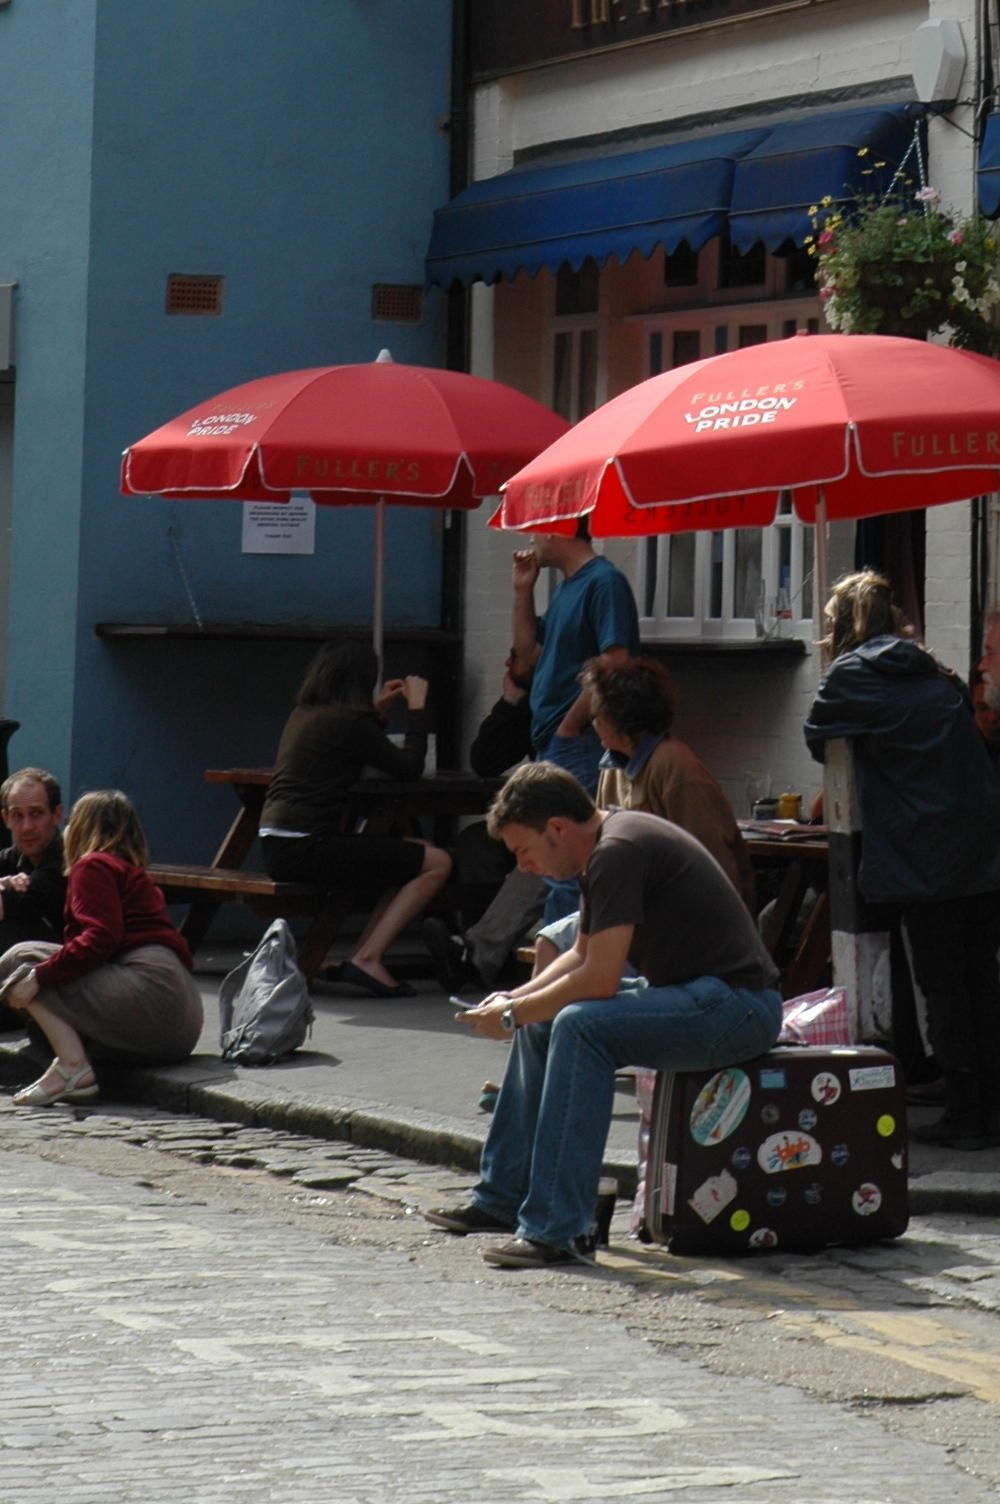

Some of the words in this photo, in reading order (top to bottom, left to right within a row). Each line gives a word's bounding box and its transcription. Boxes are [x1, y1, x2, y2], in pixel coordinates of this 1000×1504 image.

[690, 380, 805, 405] FULLER'S
[191, 412, 258, 428] LONDON
[684, 397, 798, 424] LONDON
[695, 410, 778, 433] PRIDE
[187, 424, 239, 436] PRIDE
[296, 455, 420, 481] FULLER'S
